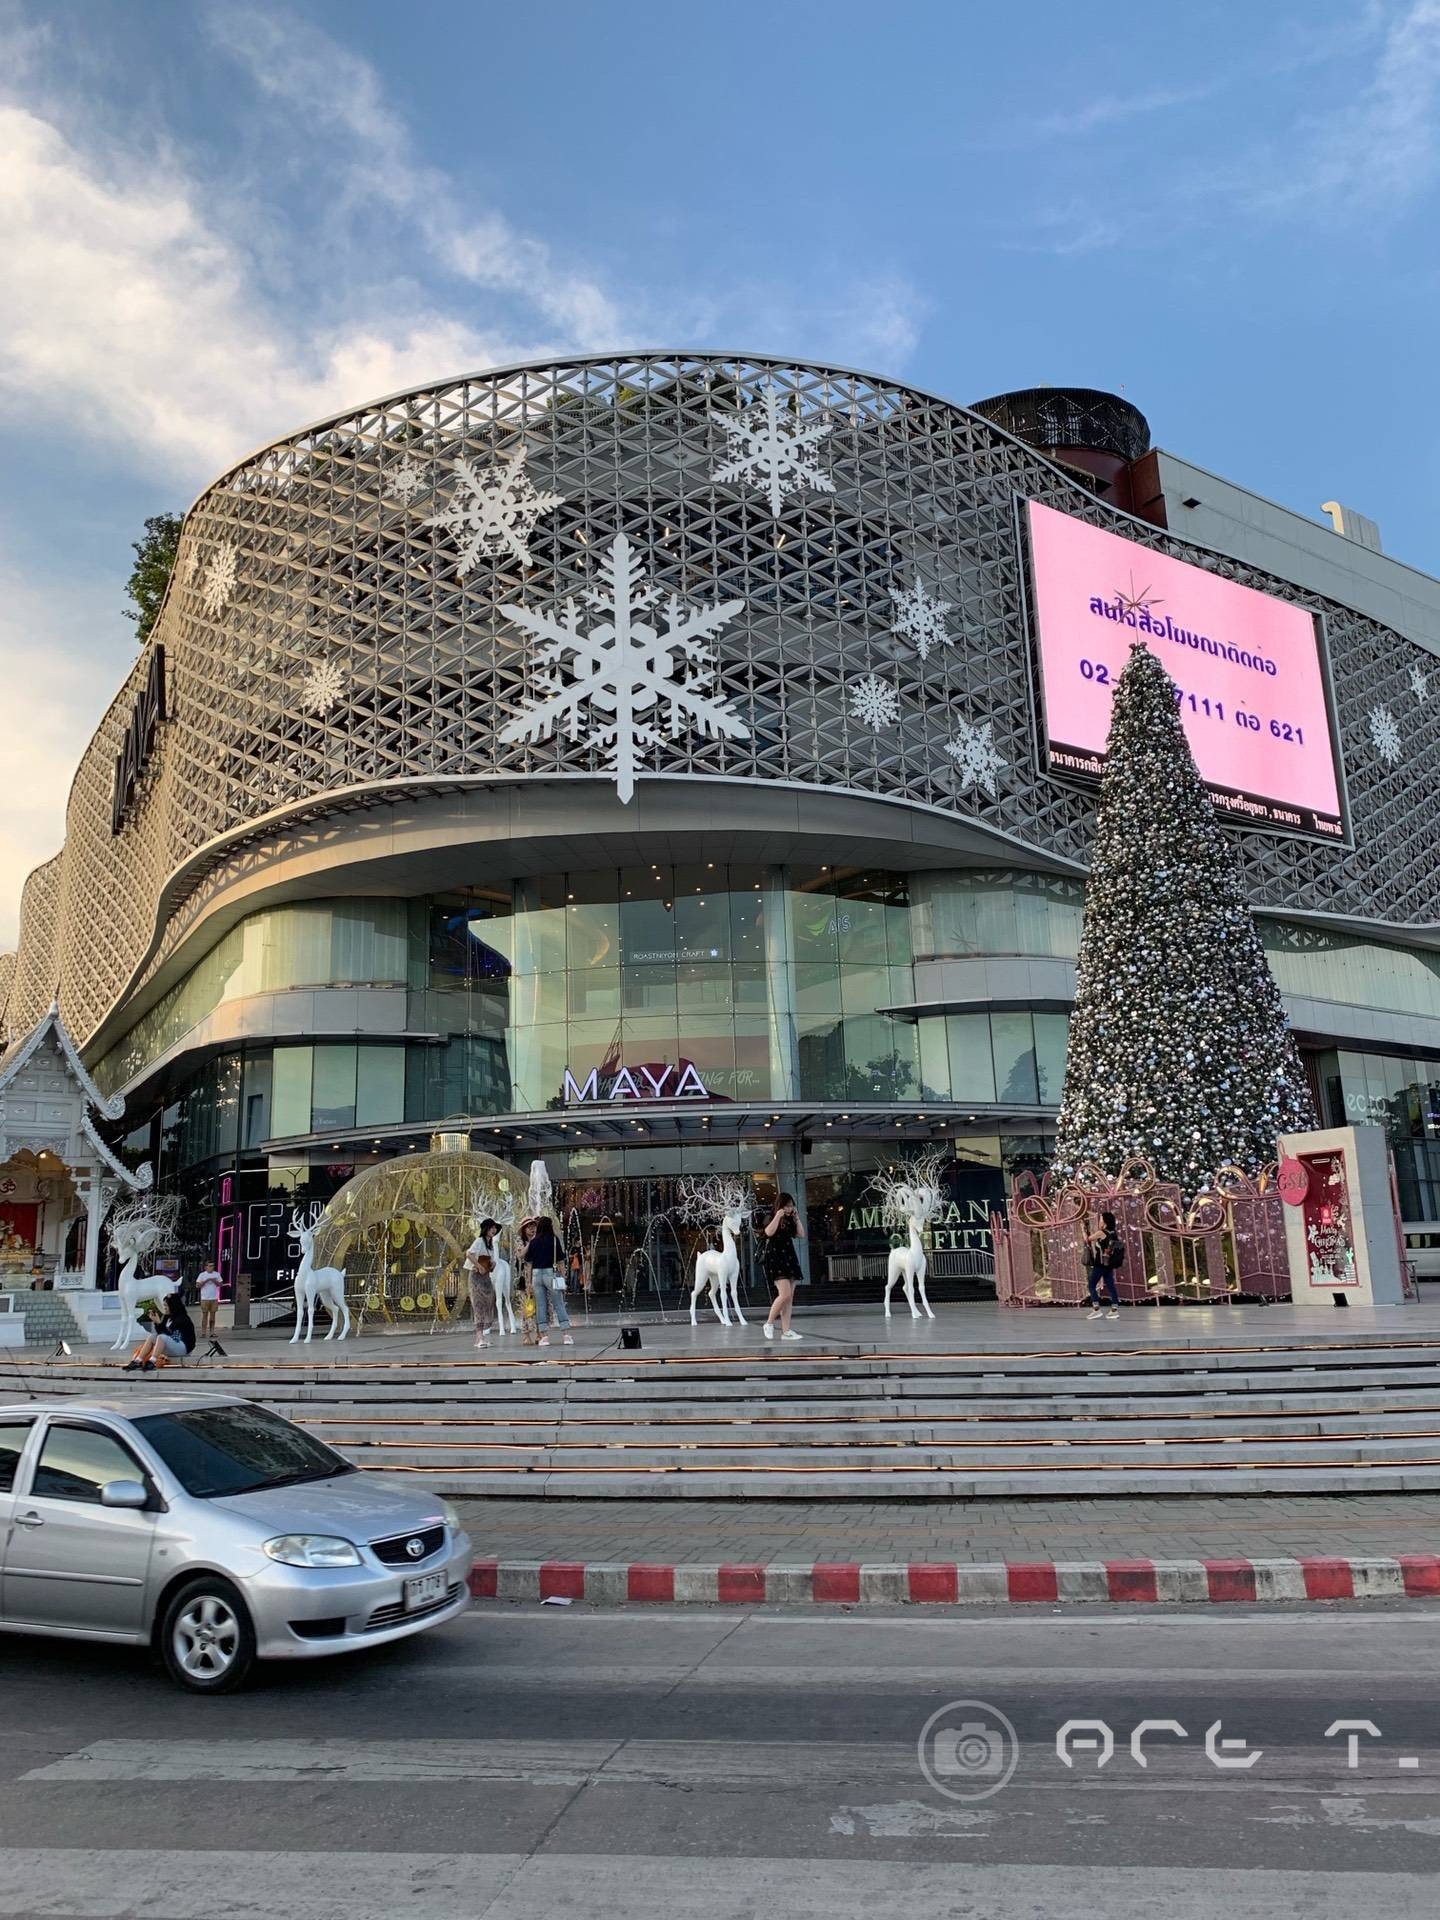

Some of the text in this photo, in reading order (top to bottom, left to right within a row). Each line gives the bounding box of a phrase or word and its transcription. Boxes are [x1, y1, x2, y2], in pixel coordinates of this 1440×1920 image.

[1235, 700, 1261, 732] ต่อ
[1269, 719, 1304, 745] 621
[828, 914, 850, 935] AIS
[564, 1062, 709, 1102] MAYA
